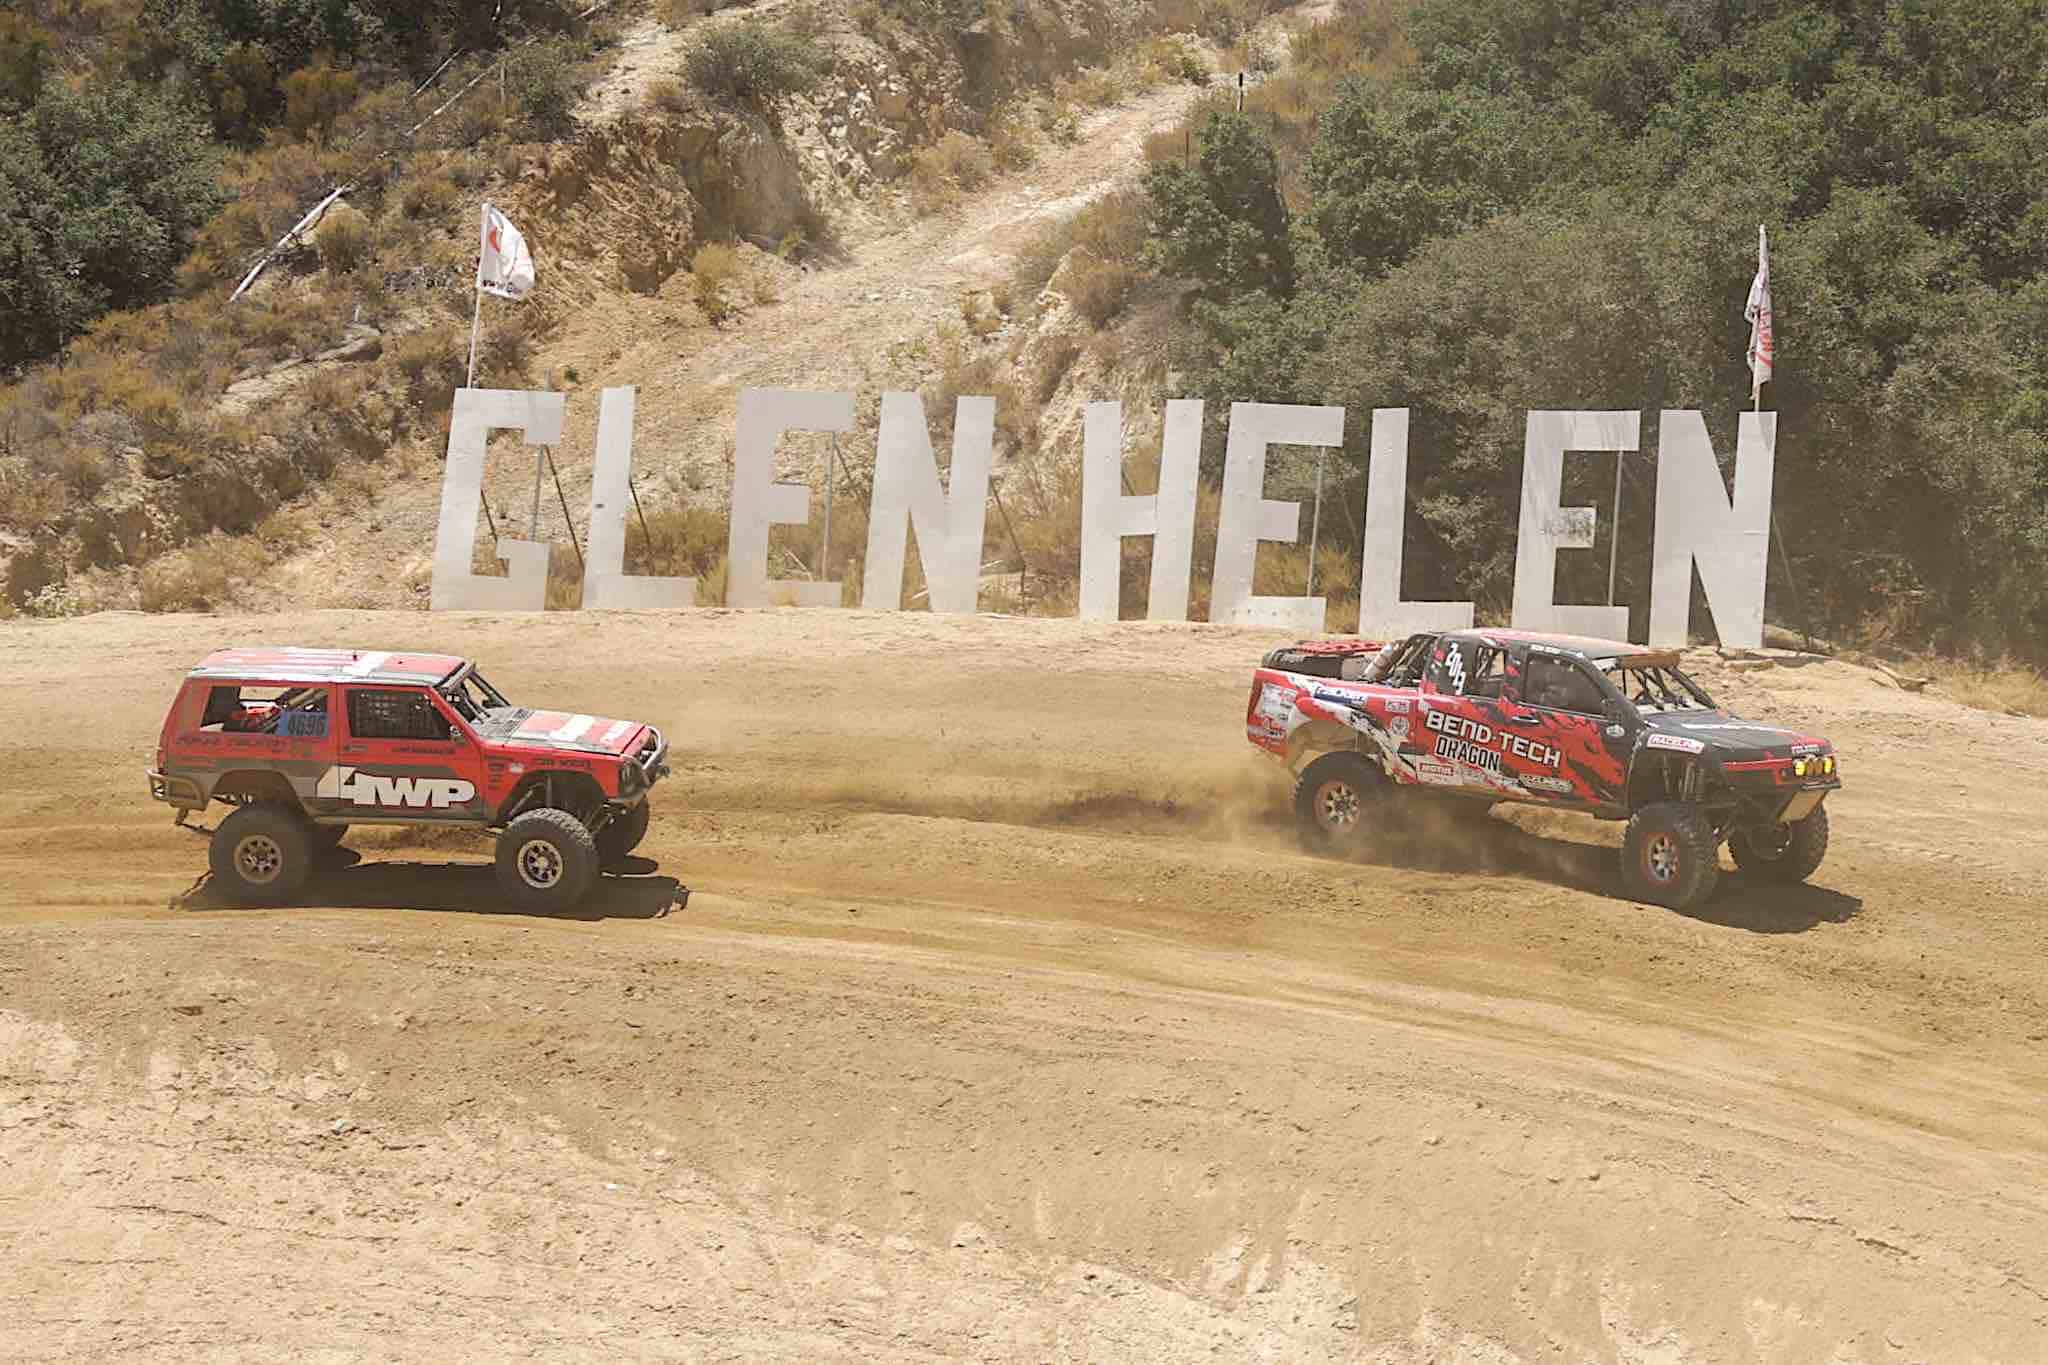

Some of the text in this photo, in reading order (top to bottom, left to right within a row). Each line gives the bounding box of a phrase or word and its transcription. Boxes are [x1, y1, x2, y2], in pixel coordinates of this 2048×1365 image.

[431, 385, 1777, 649] GLEN HELEN
[1433, 734, 1501, 775] DRAGON
[316, 764, 477, 808] 4WP
